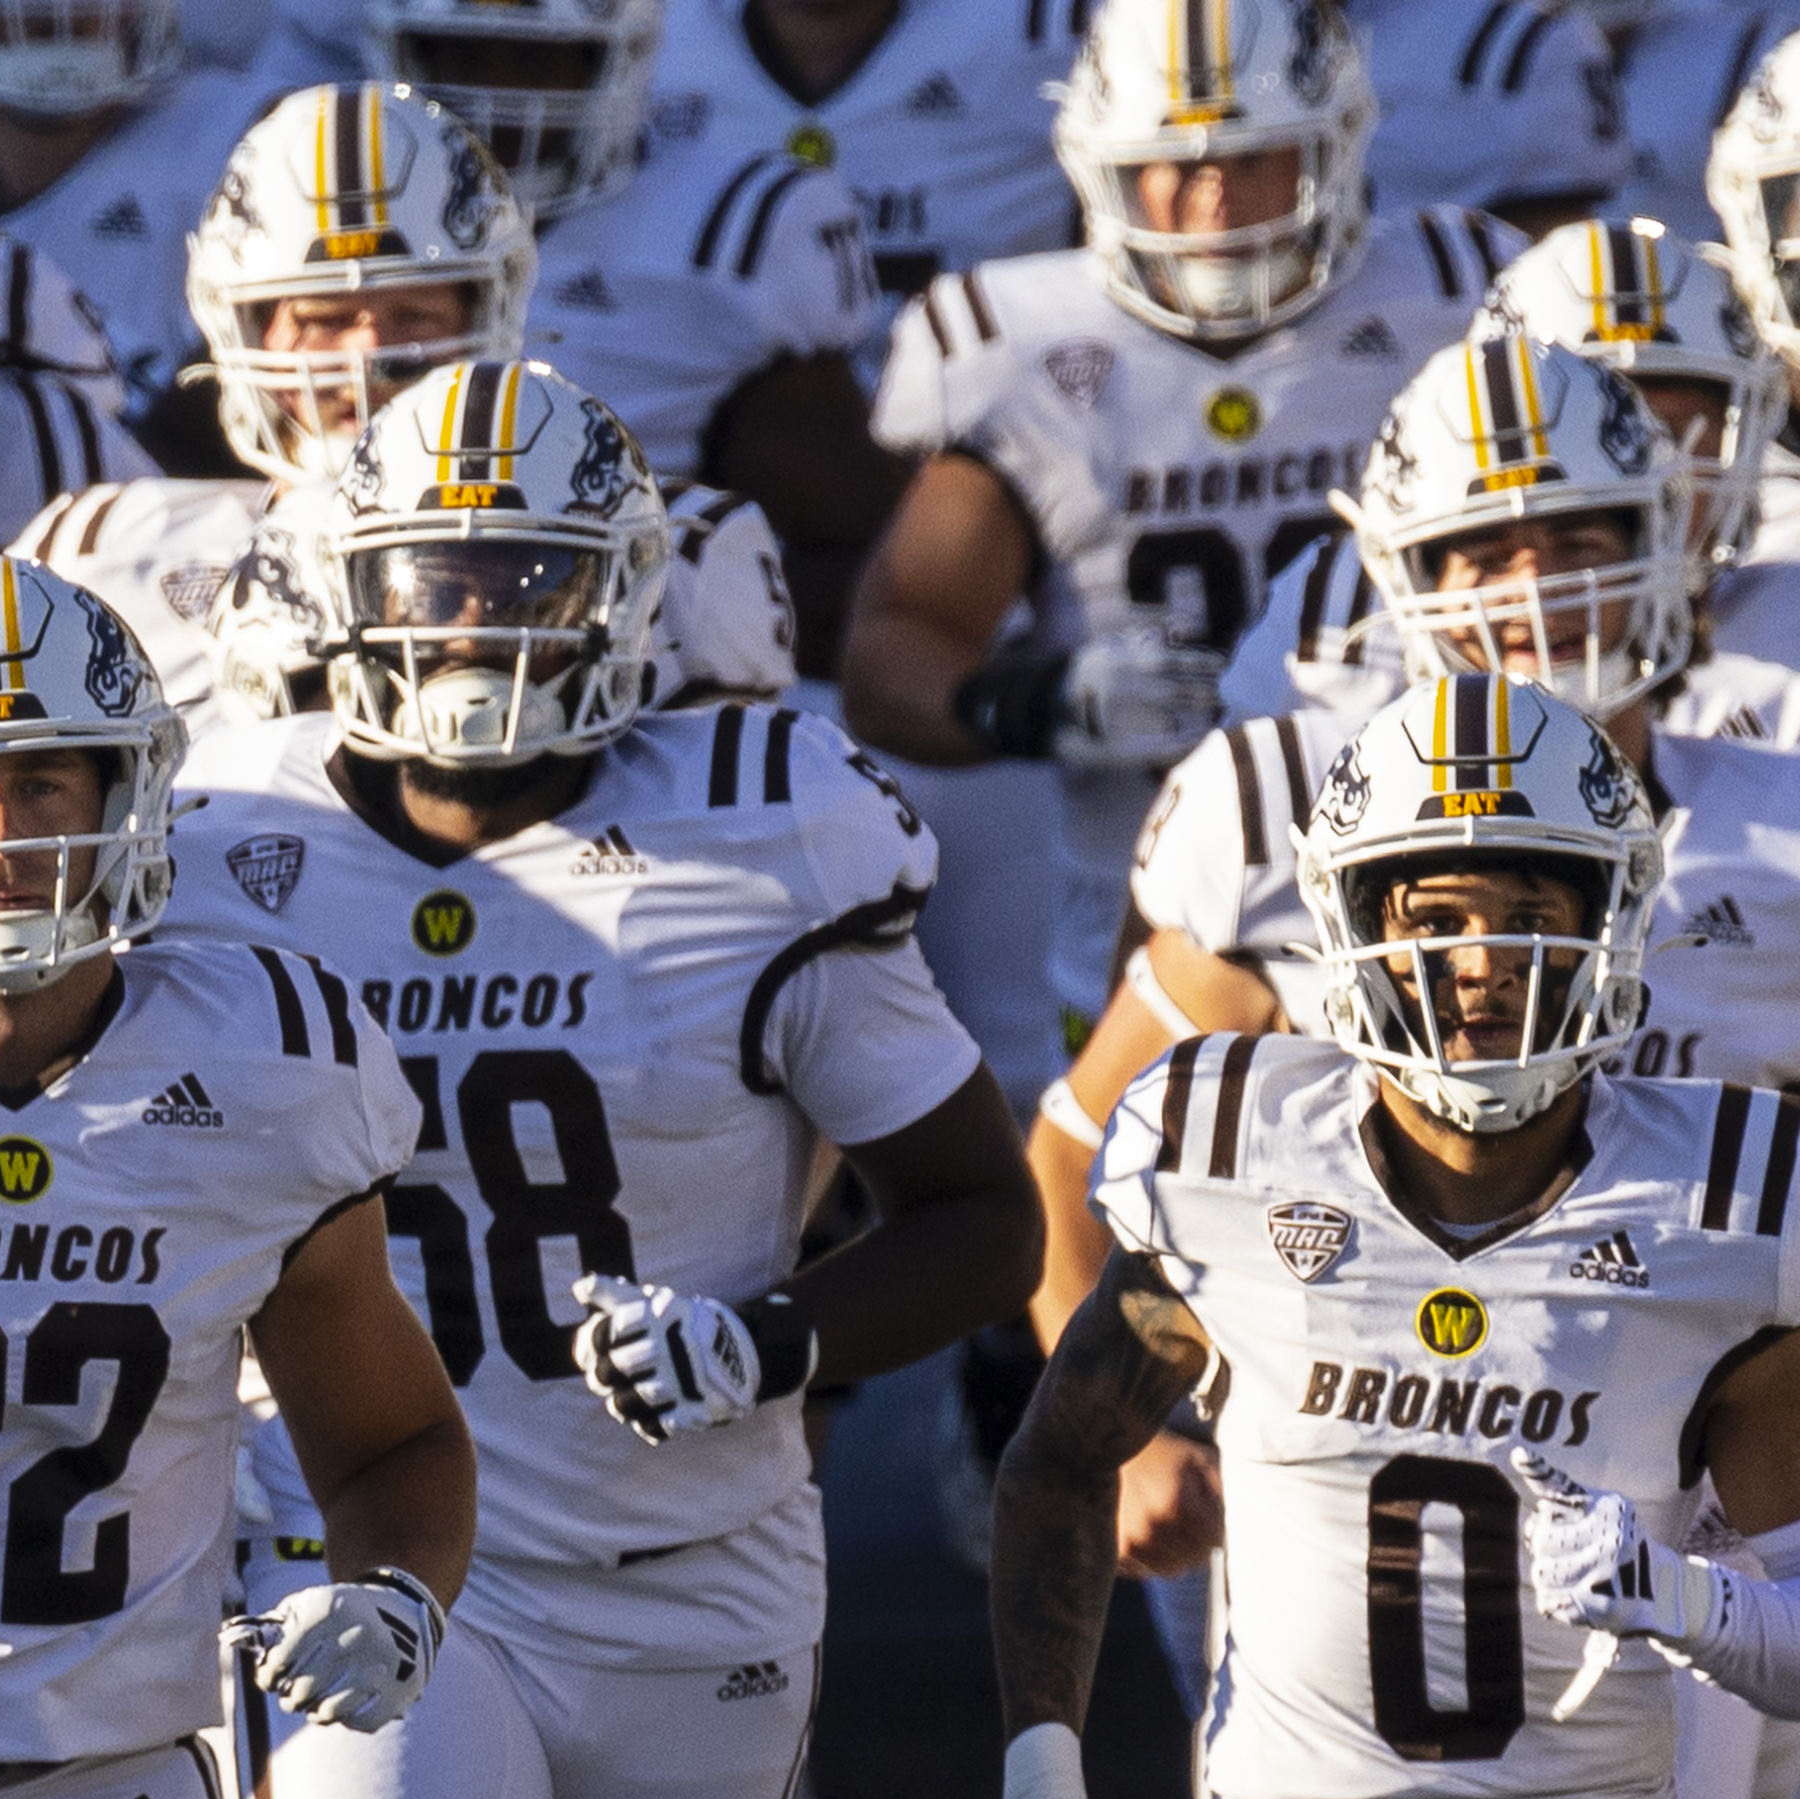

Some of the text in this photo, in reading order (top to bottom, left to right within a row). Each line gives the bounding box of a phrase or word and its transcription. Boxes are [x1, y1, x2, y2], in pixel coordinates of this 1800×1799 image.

[440, 484, 497, 508] EAT
[1443, 793, 1500, 817] EAT
[423, 906, 464, 945] W
[142, 1104, 224, 1129] adidas
[1272, 1226, 1347, 1250] MAC
[1569, 1260, 1649, 1290] adidas
[1429, 1304, 1477, 1346] W
[1299, 1361, 1601, 1447] BRONCOS
[1368, 1455, 1526, 1763] 0
[716, 1671, 789, 1703] adidas
